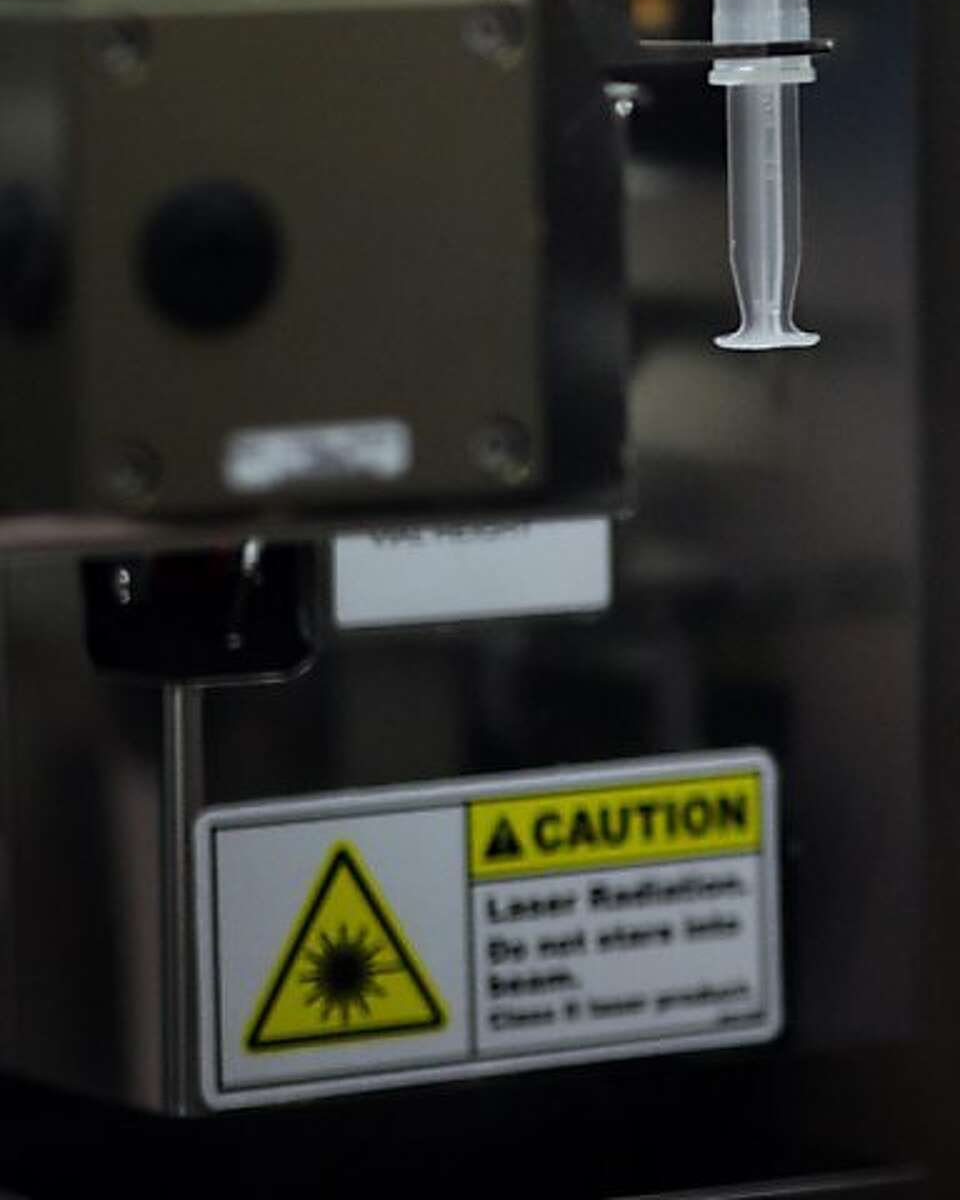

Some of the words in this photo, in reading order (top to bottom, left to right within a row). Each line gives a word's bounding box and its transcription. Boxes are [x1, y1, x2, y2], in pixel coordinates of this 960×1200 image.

[533, 795, 747, 852] CAUTION
[487, 892, 576, 923] Laser
[488, 938, 527, 963] Do
[537, 931, 587, 956] not
[598, 924, 673, 948] stare
